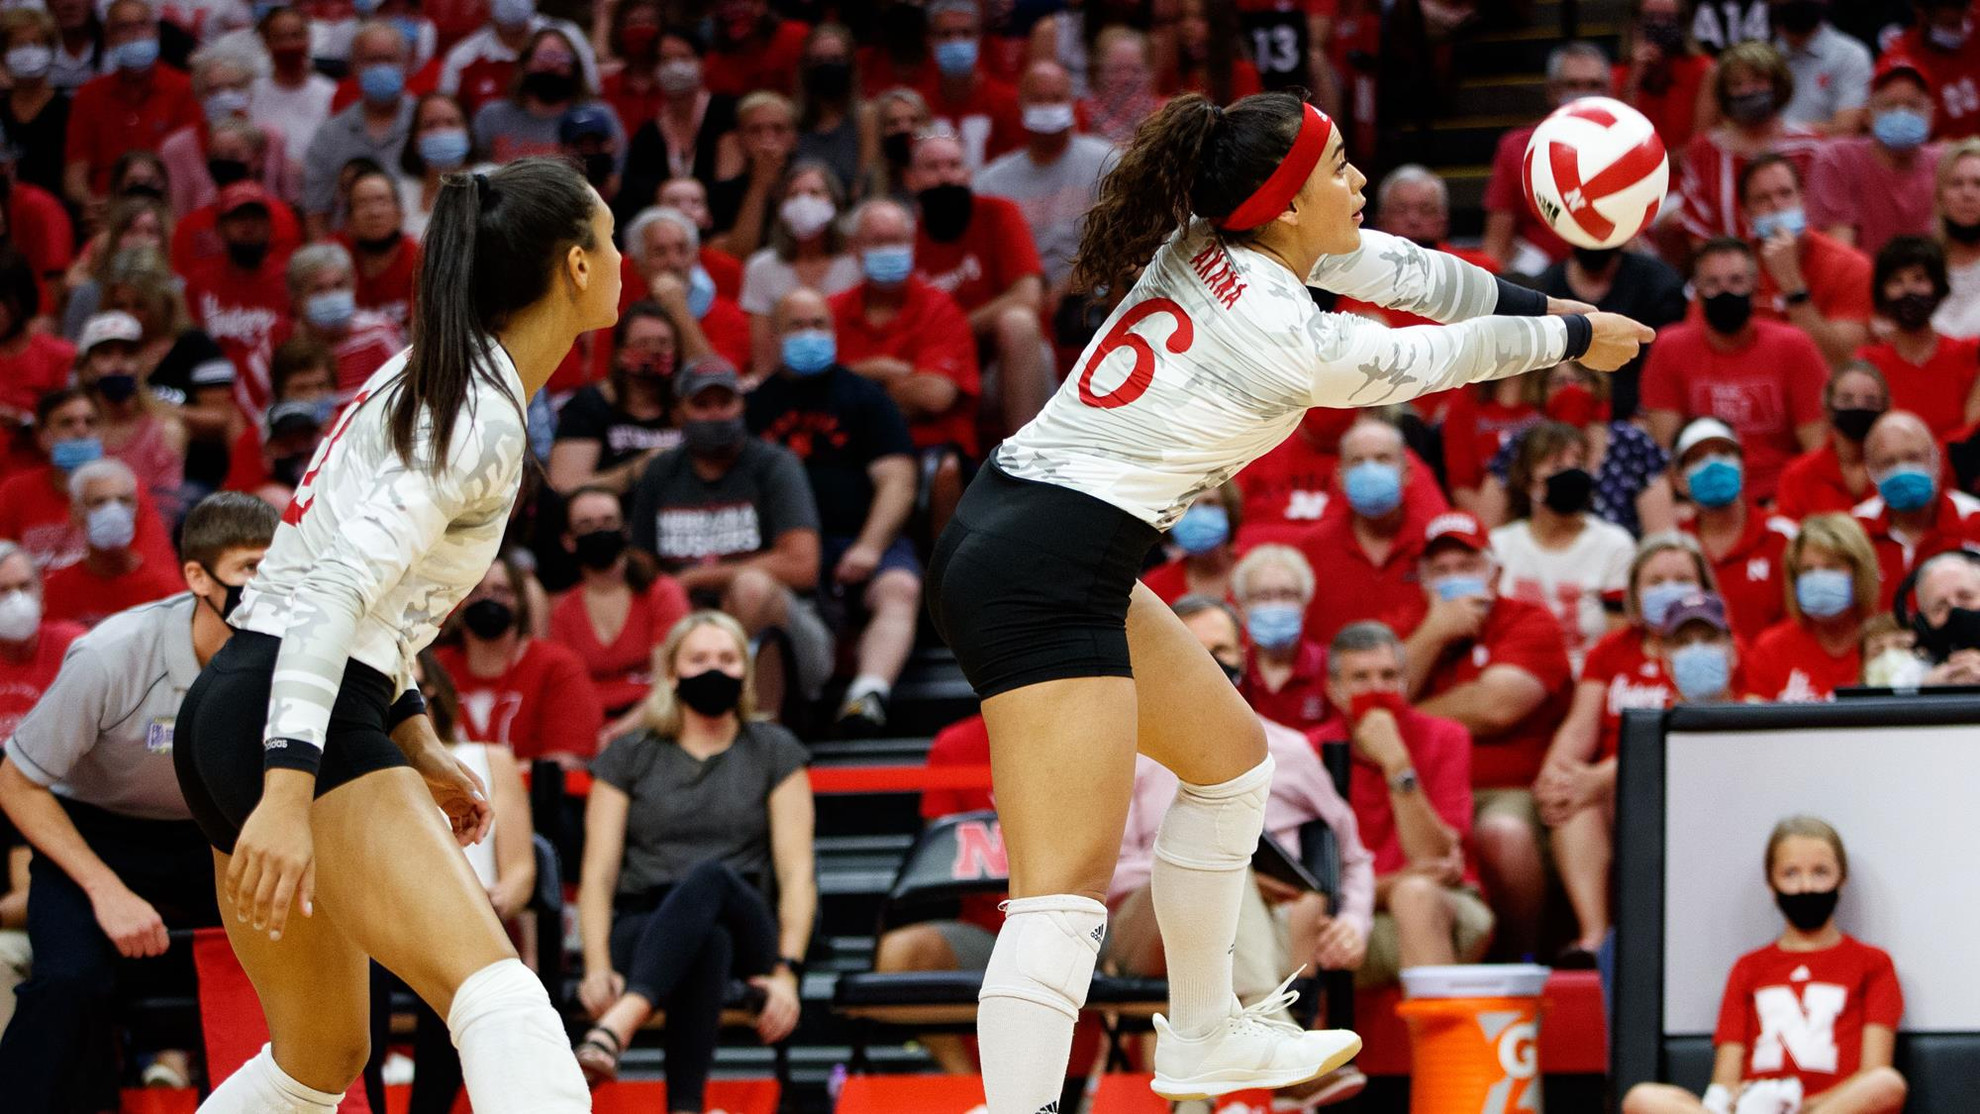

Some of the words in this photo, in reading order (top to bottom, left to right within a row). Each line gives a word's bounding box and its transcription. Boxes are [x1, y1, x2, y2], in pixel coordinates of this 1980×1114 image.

[1563, 187, 1587, 214] N
[1189, 239, 1248, 311] AKANA
[1078, 297, 1194, 409] 6
[1746, 557, 1770, 582] N
[264, 738, 288, 755] didas
[952, 821, 1009, 880] N
[1497, 1021, 1539, 1081] G
[1752, 982, 1847, 1075] N
